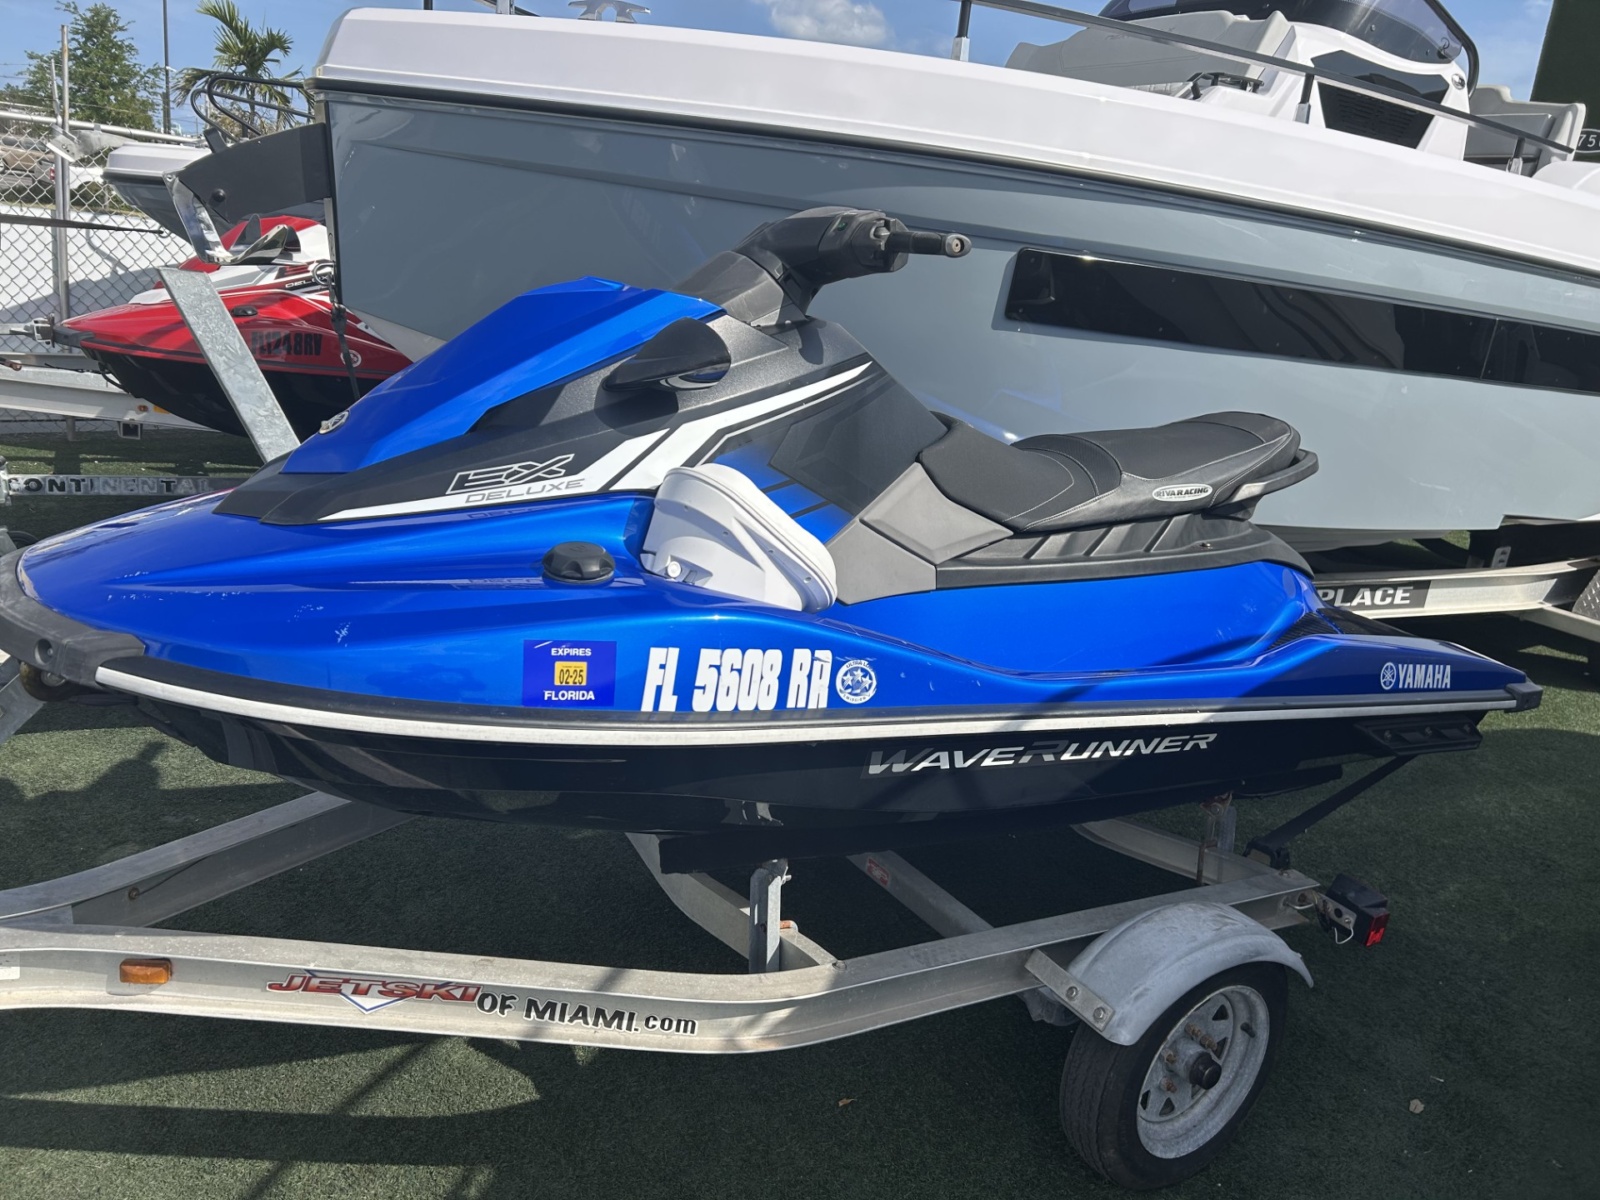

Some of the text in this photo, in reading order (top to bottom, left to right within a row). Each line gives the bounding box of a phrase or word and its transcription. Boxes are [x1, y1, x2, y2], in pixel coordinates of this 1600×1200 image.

[1578, 134, 1600, 147] 75
[445, 453, 575, 494] EX
[465, 478, 585, 503] DELUXE
[551, 648, 592, 656] EXPIRES
[559, 669, 584, 685] 02-25
[640, 647, 680, 712] FL
[692, 648, 783, 712] 5608
[1398, 664, 1451, 689] YAMAHA
[544, 690, 595, 701] FLORIDA
[267, 975, 481, 1002] JETSKI
[477, 992, 518, 1016] OF
